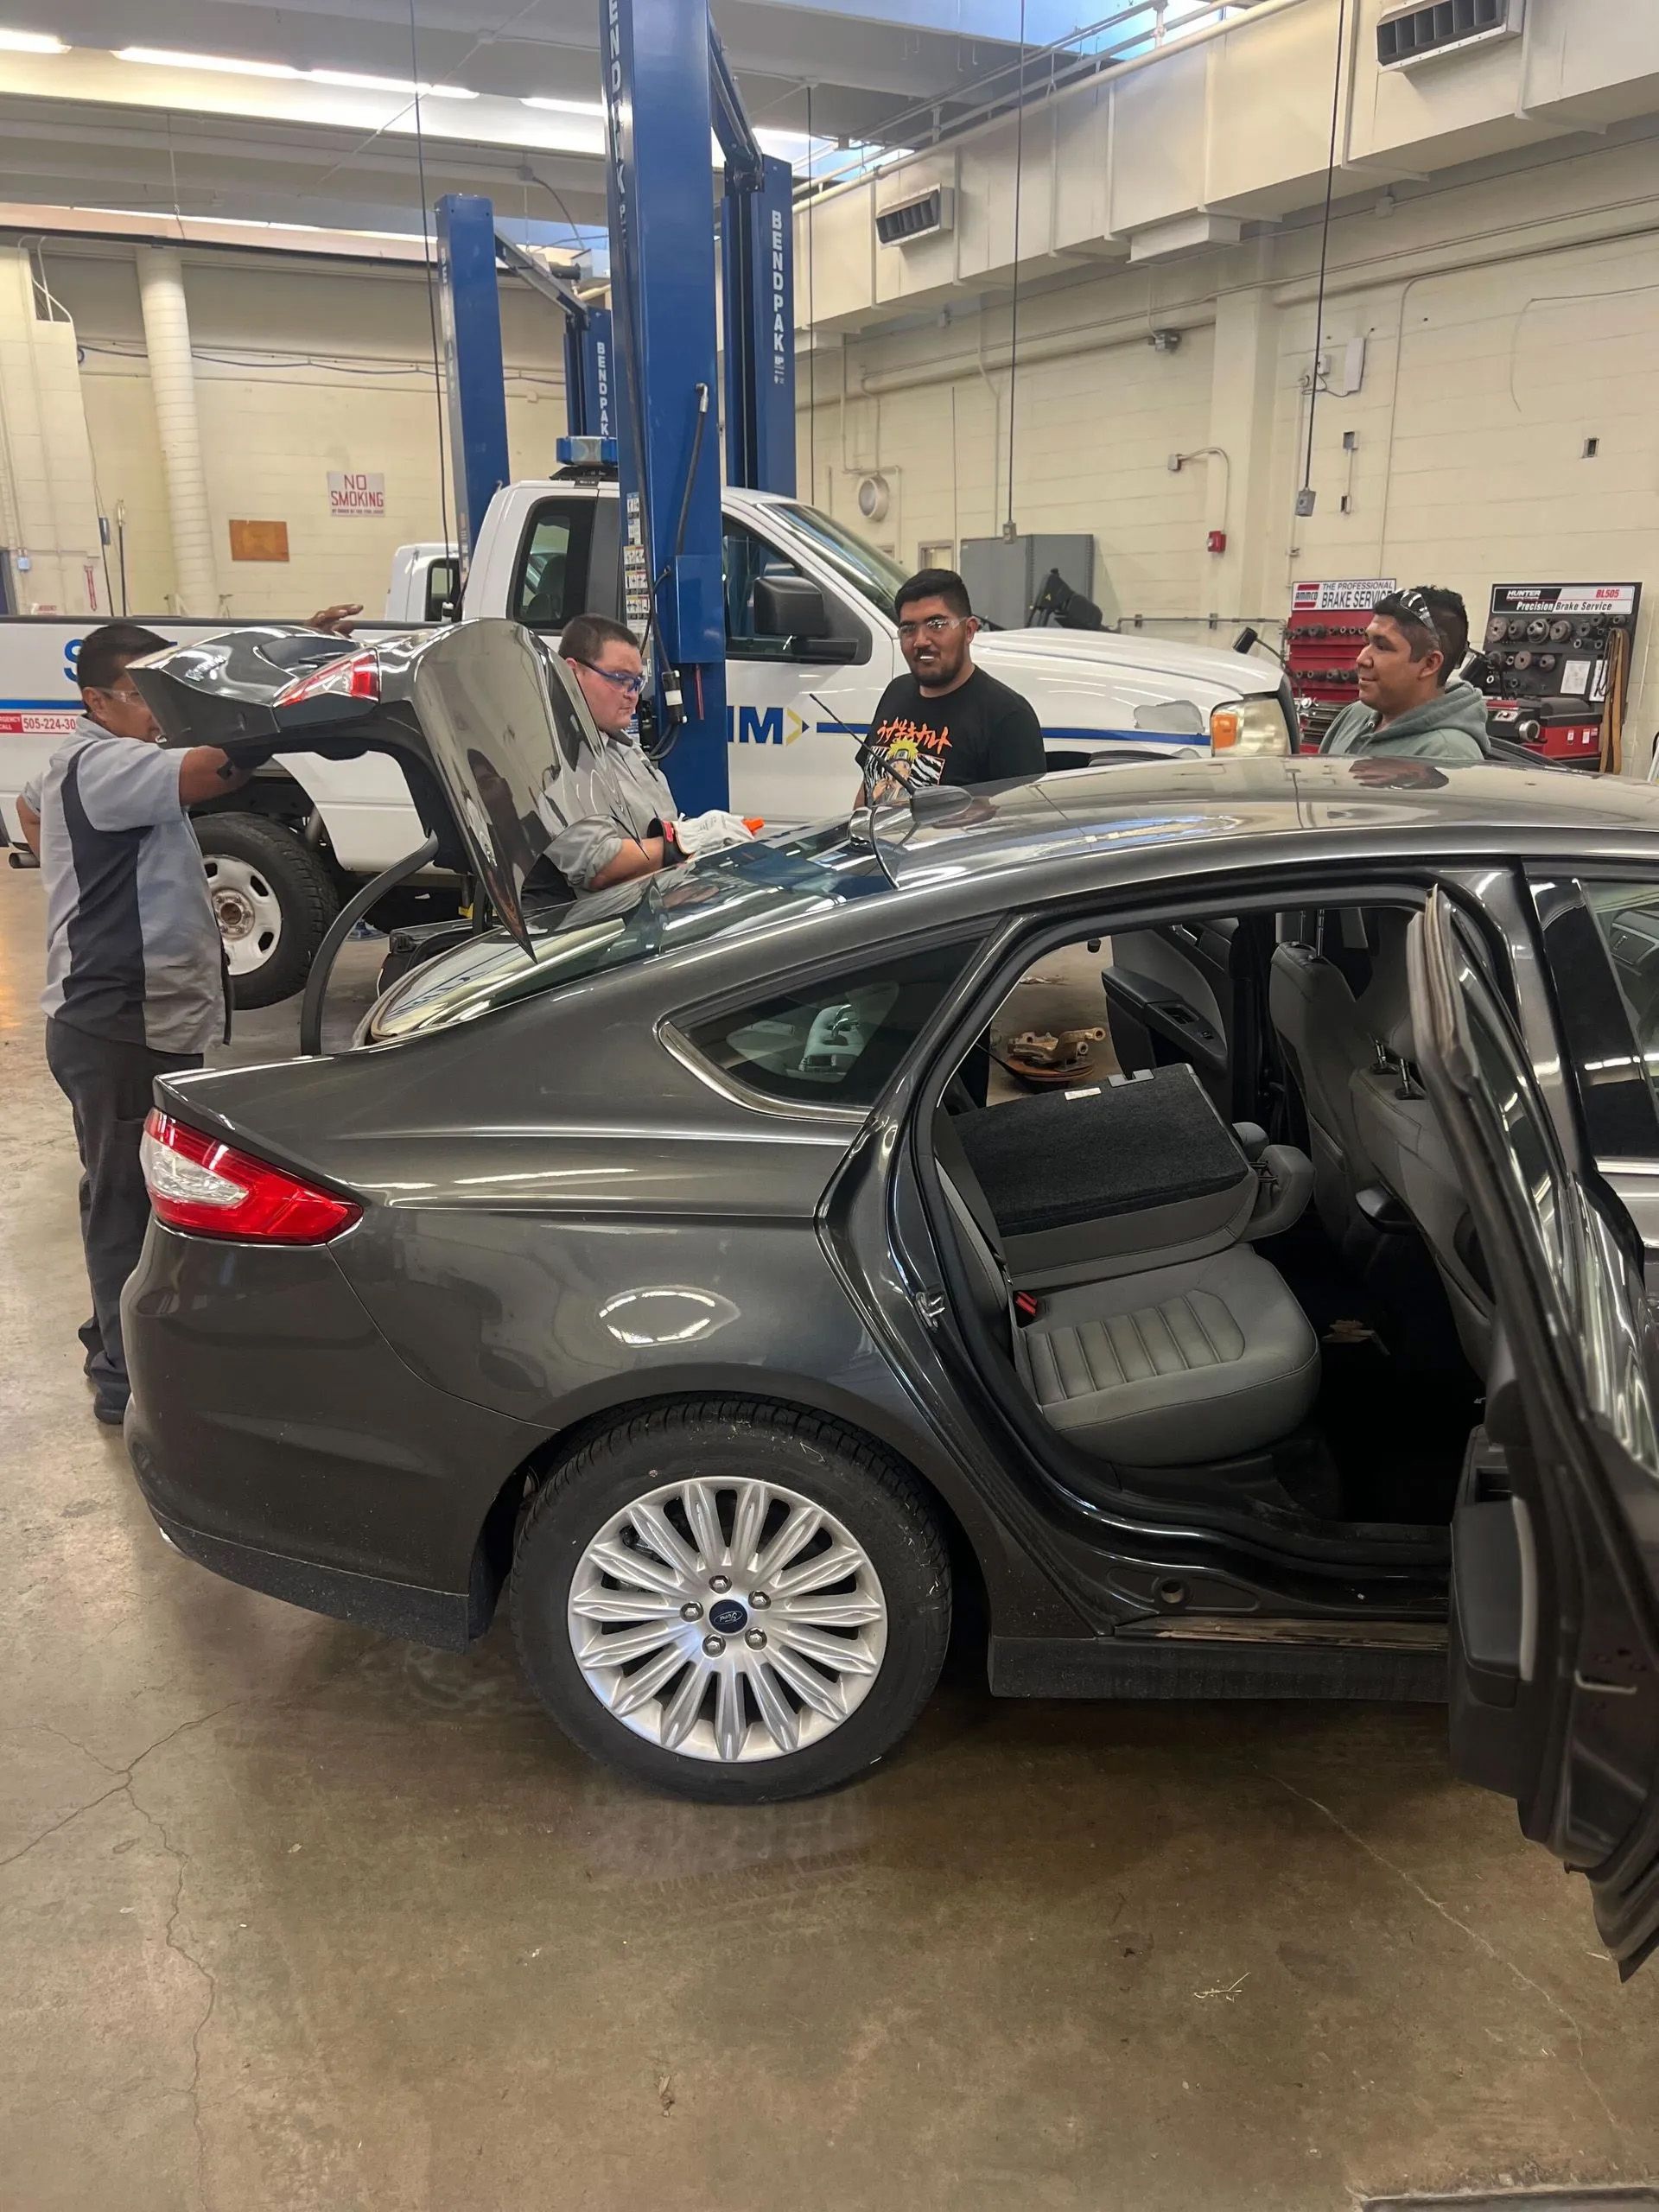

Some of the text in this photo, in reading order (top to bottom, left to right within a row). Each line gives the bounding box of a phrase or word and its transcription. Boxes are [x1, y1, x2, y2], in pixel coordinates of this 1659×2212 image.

[772, 209, 785, 353] BENDPAK
[597, 341, 609, 436] BENDPAK
[344, 474, 367, 491] NO
[331, 491, 385, 507] SMOKING
[1338, 581, 1393, 591] PROFESSIONAL
[1595, 589, 1620, 599] BL505
[1321, 590, 1393, 608] BRAKE SERVIC
[1516, 601, 1612, 612] Precision Brake Service
